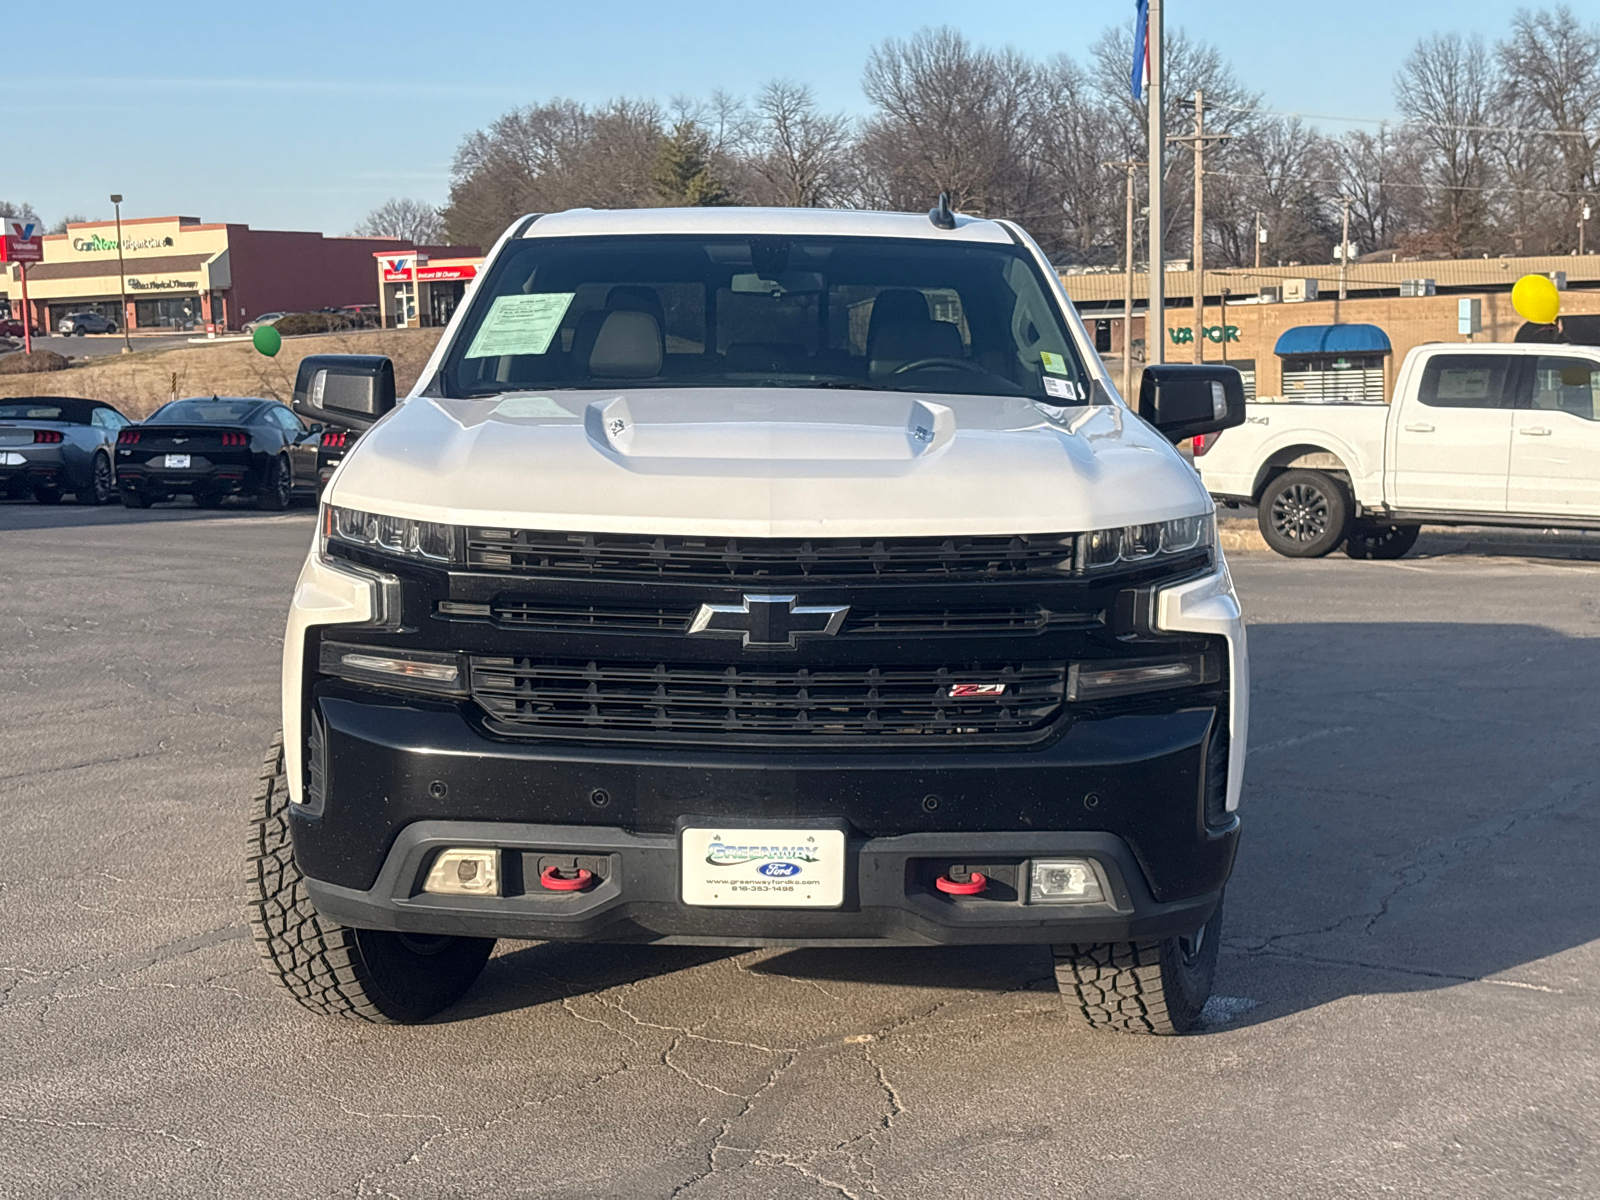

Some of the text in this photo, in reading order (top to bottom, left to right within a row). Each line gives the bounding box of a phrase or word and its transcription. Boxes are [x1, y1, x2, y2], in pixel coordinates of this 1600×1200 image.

[1246, 416, 1270, 426] X4
[948, 684, 1006, 697] Z71
[707, 843, 819, 860] GREENWAY
[765, 863, 794, 876] Ford
